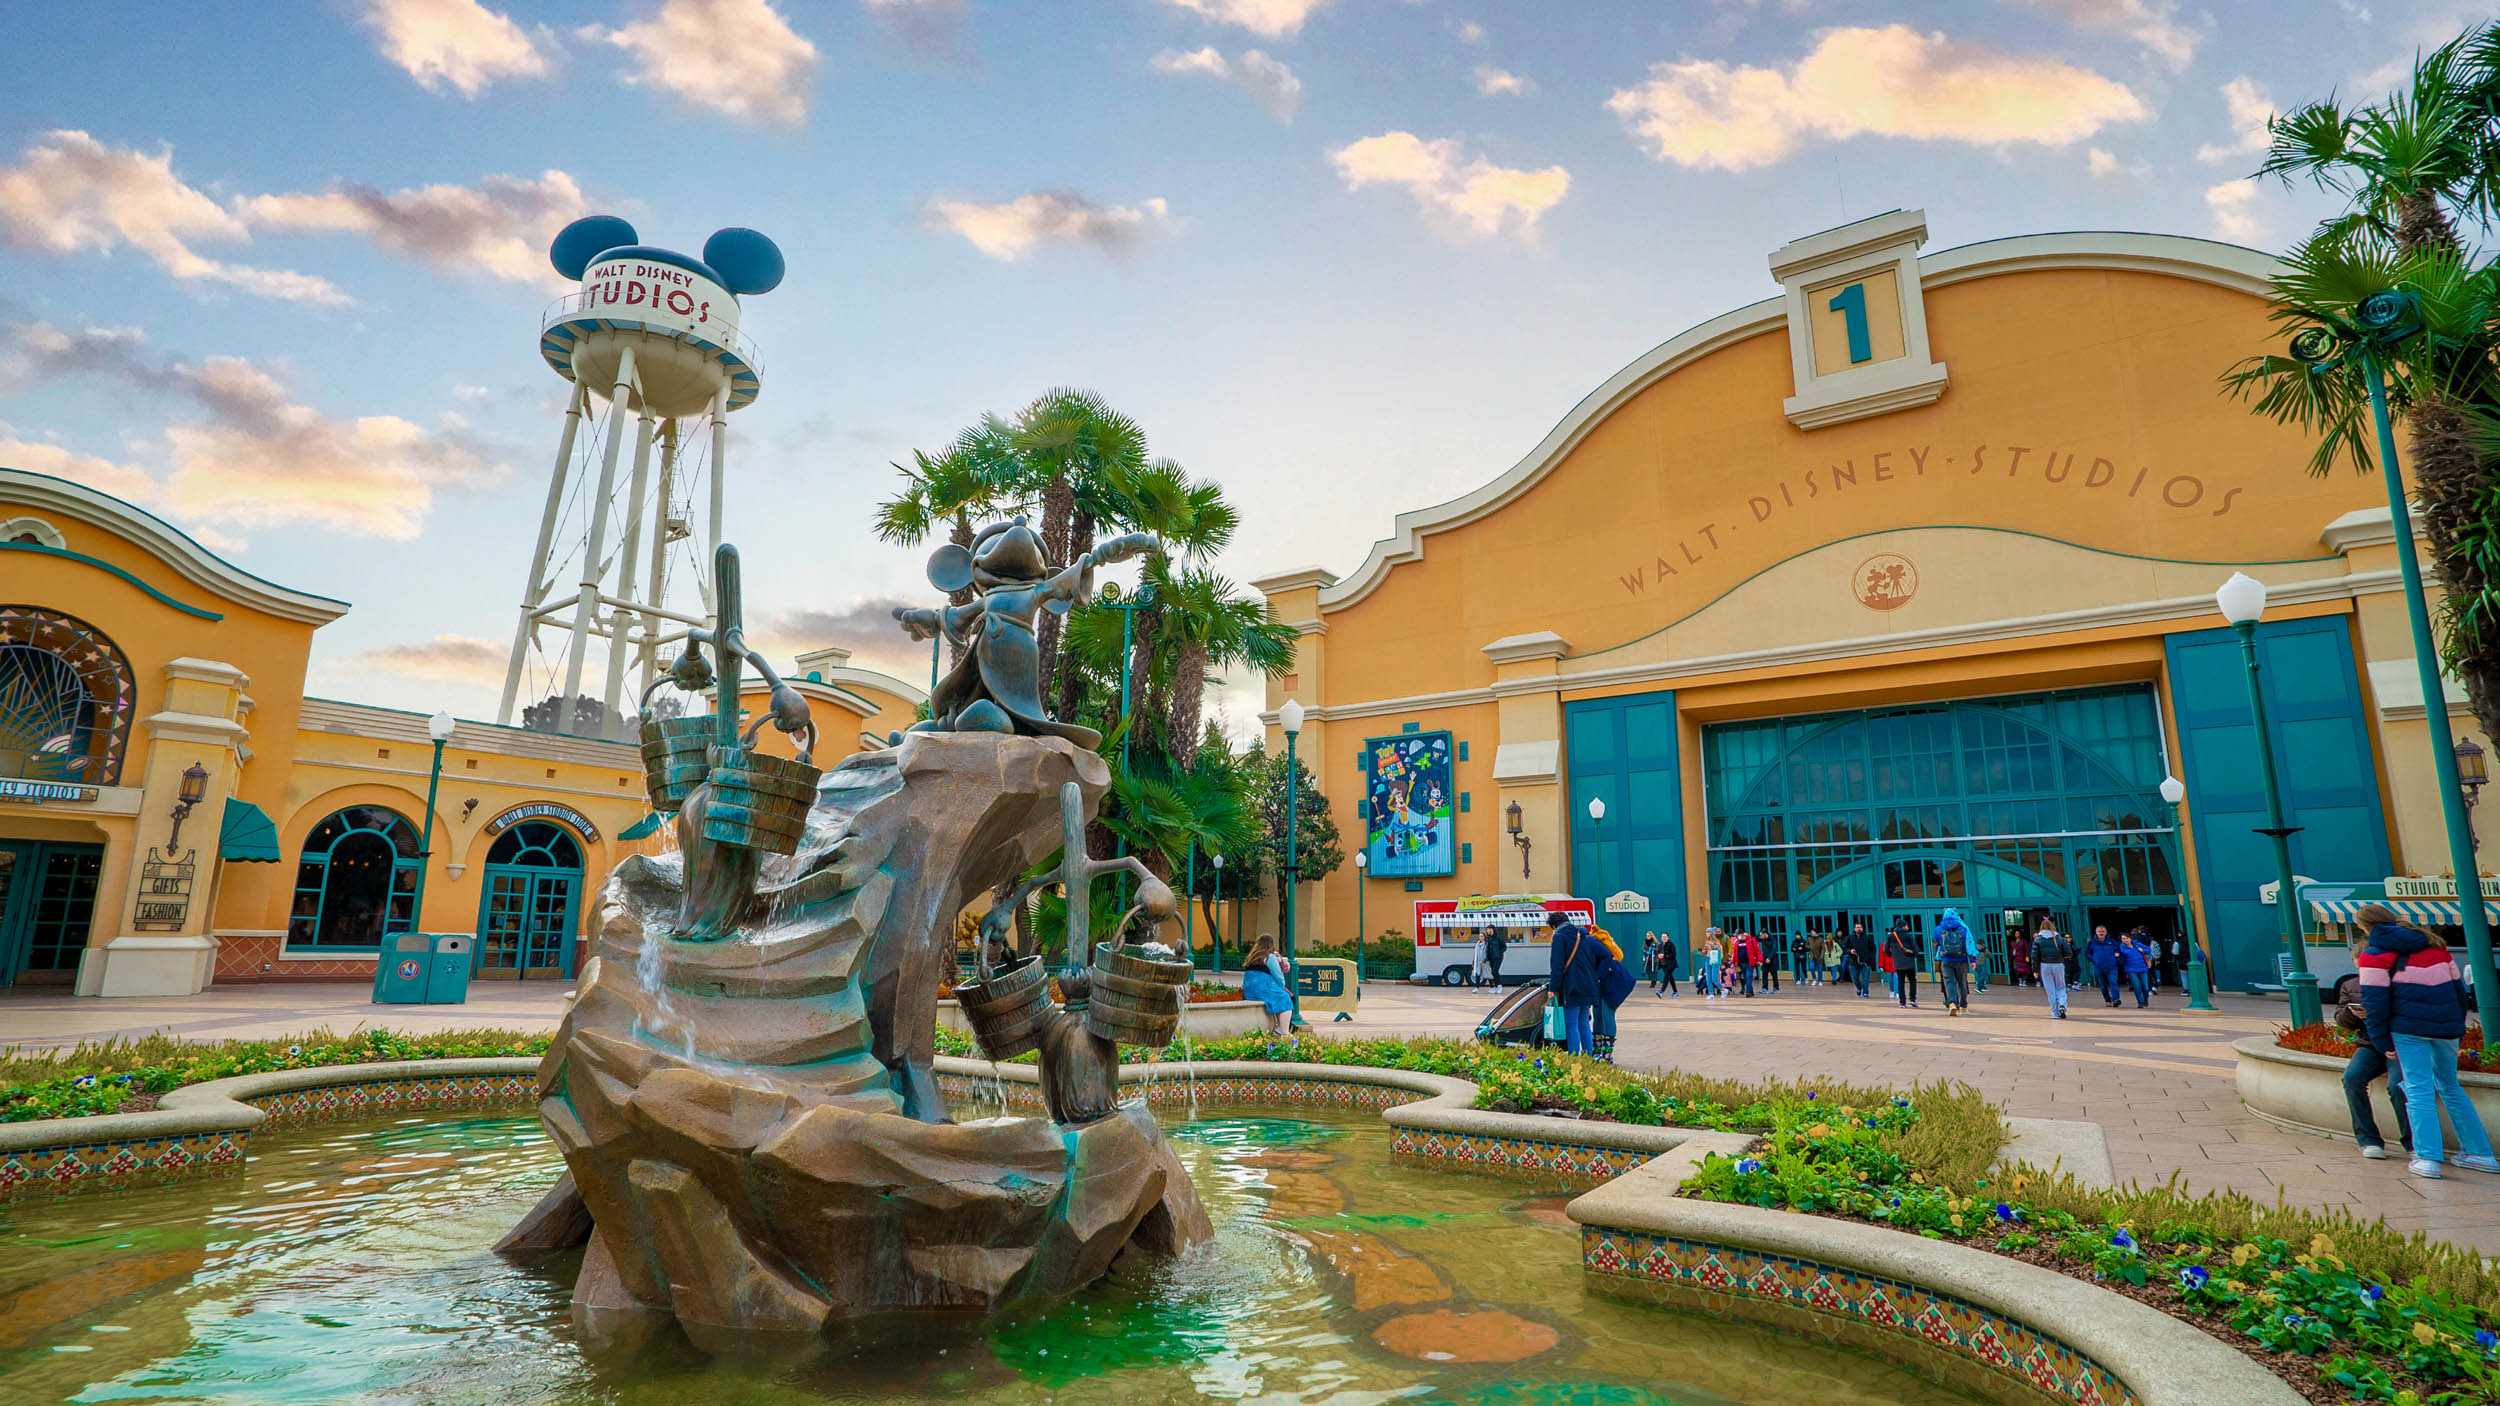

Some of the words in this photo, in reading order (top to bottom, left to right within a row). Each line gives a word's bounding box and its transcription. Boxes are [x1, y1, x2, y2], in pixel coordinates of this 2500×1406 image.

[595, 264, 626, 279] WALT
[636, 265, 693, 288] DISNEY
[586, 280, 710, 322] TUDIOS
[1829, 283, 1872, 364] 1
[1619, 523, 1722, 597] WALT
[1748, 446, 1931, 522] DISNEY
[1970, 444, 2243, 517] STUDIOS
[1376, 743, 1395, 759] TOY
[24, 783, 77, 800] STUDIOS
[522, 805, 545, 816] DISNEY
[153, 878, 180, 894] GIFTS
[2395, 881, 2440, 895] STUDIO
[142, 904, 181, 919] FASHION
[1609, 902, 1640, 910] STUDIO
[1318, 969, 1338, 981] SORTIE
[1318, 981, 1331, 992] EXIT
